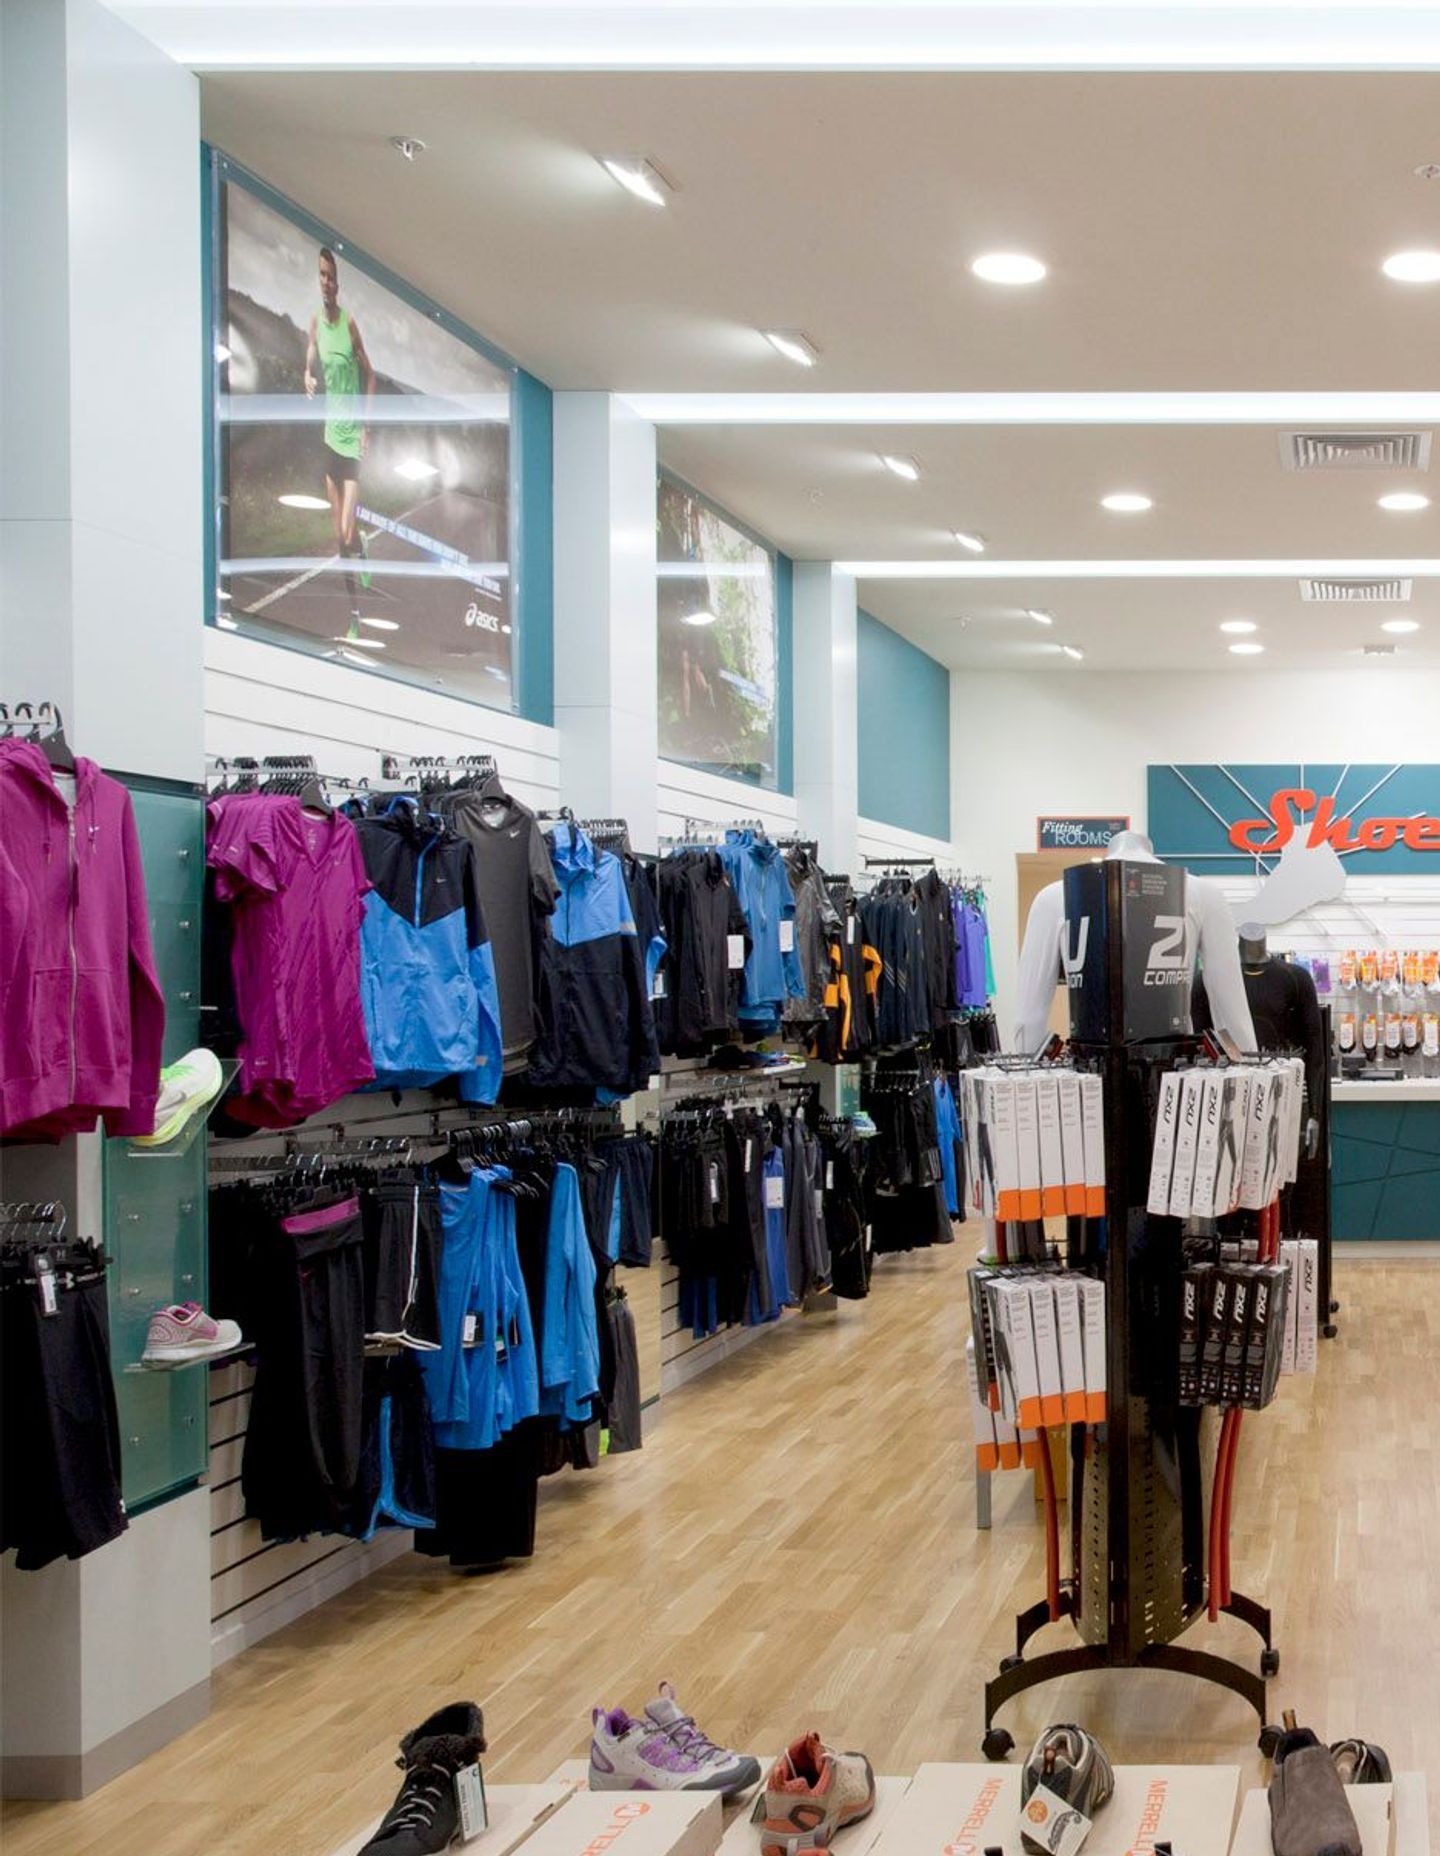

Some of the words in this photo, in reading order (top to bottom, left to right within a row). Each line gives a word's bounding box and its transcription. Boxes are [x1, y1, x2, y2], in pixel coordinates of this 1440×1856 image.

[1042, 820, 1084, 834] Fitting
[1055, 830, 1112, 846] ROOMS
[1163, 1085, 1174, 1125] 2XU
[1185, 1087, 1197, 1127] 2XU
[1207, 1086, 1218, 1126] 2XU
[1255, 1083, 1266, 1122] 2XU
[1184, 1280, 1196, 1321] 2XU
[1213, 1280, 1227, 1321] 2XU
[1233, 1282, 1247, 1323] 2XU
[1255, 1282, 1268, 1323] 2XU
[956, 1778, 1003, 1842] MERRELL
[1132, 1779, 1168, 1851] MERRELL
